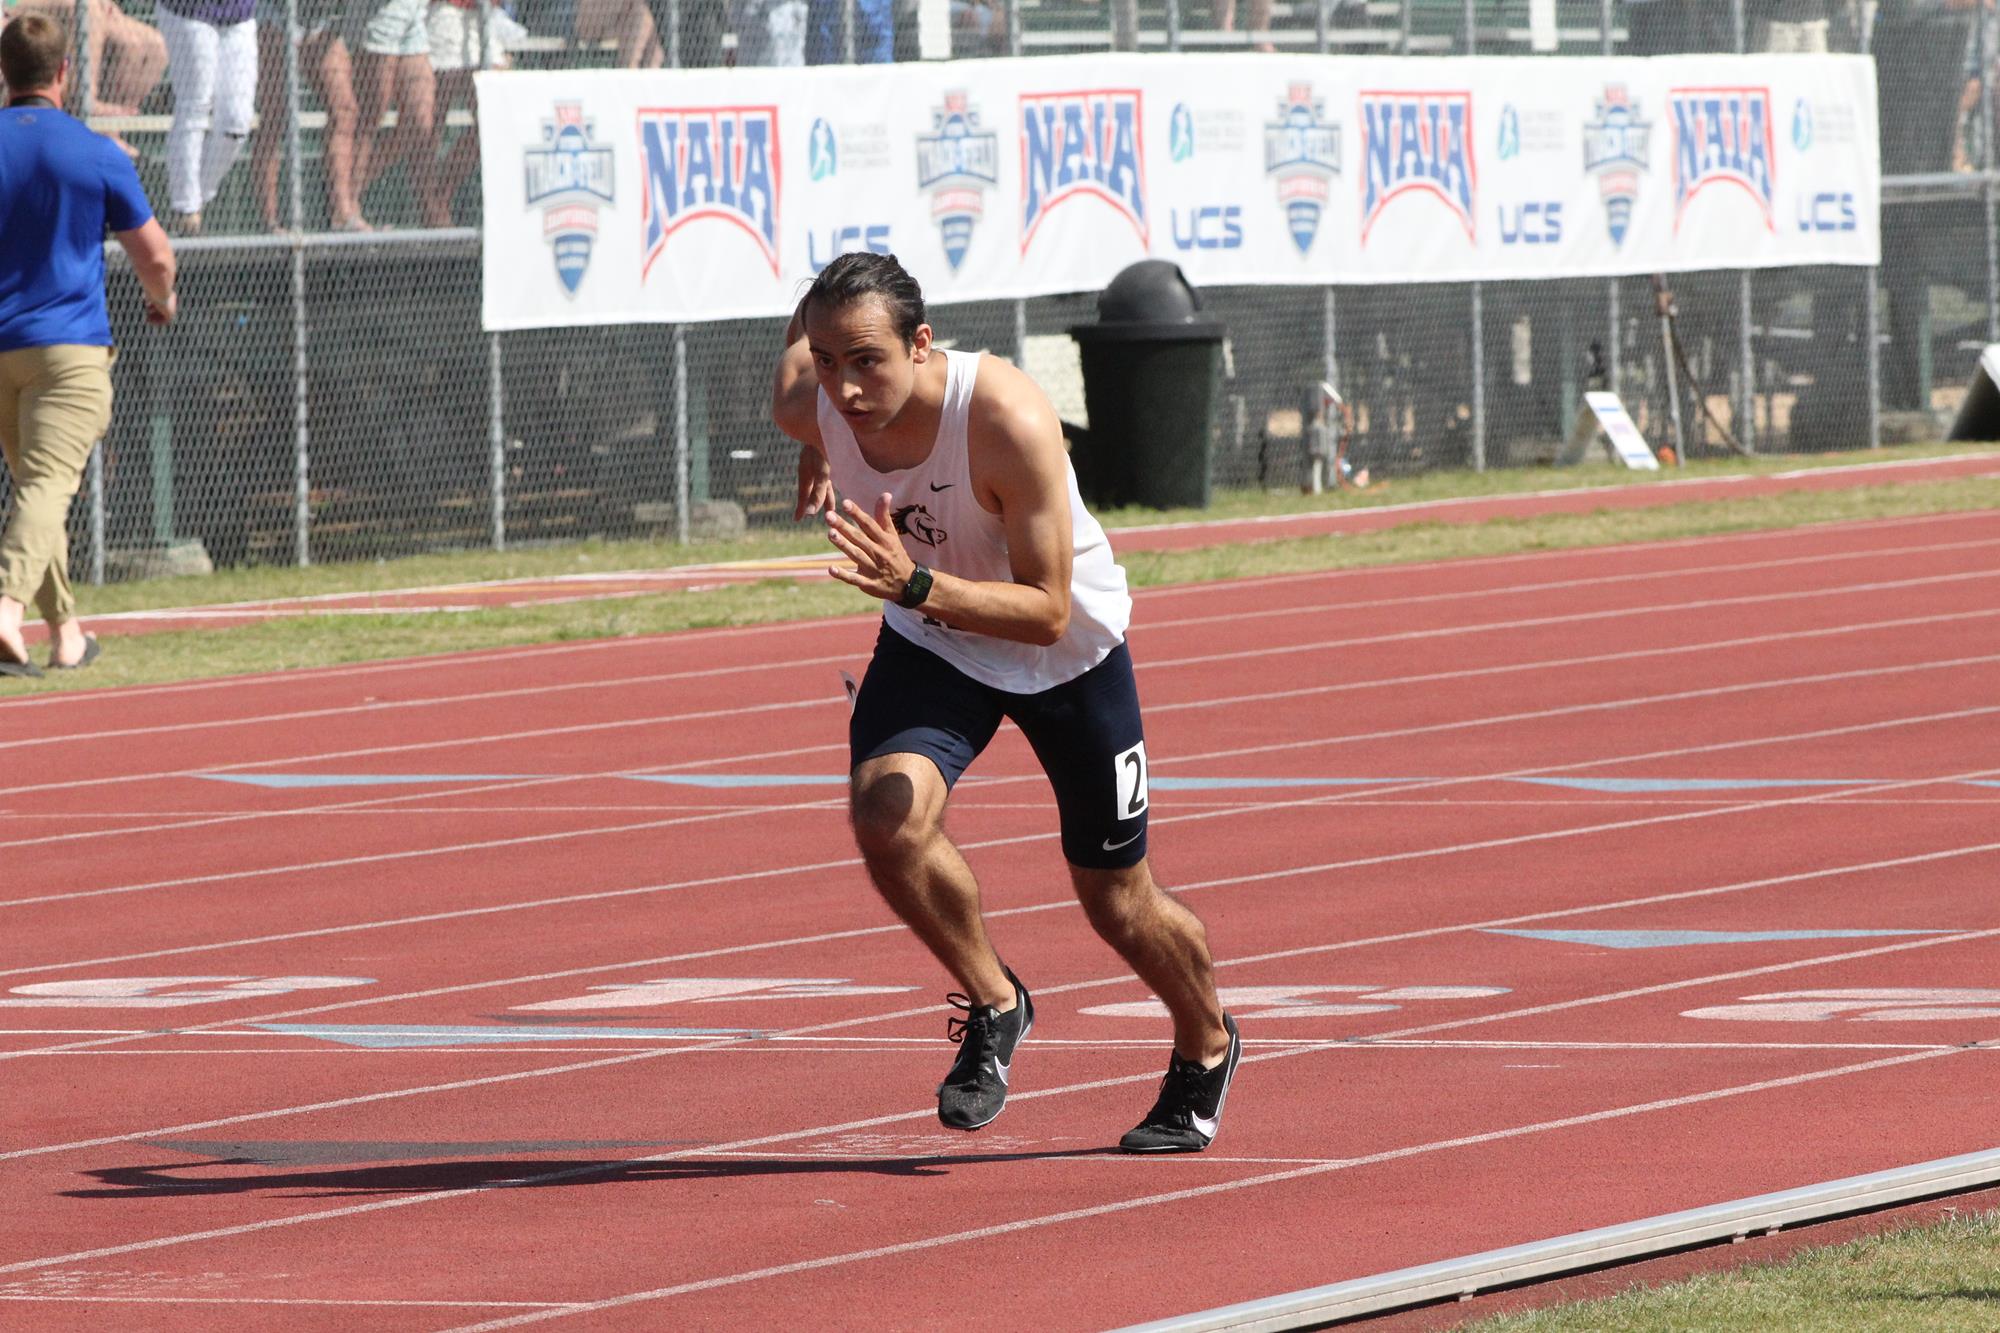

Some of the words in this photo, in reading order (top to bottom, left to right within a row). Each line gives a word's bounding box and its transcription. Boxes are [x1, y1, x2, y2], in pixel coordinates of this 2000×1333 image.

[640, 113, 778, 254] NAIA
[1023, 101, 1145, 230] NAIA
[1362, 102, 1473, 216] NAIA
[1672, 99, 1772, 206] NAIA
[1171, 205, 1243, 250] UCS
[1499, 202, 1562, 244] UCS
[1124, 751, 1145, 815] 2
